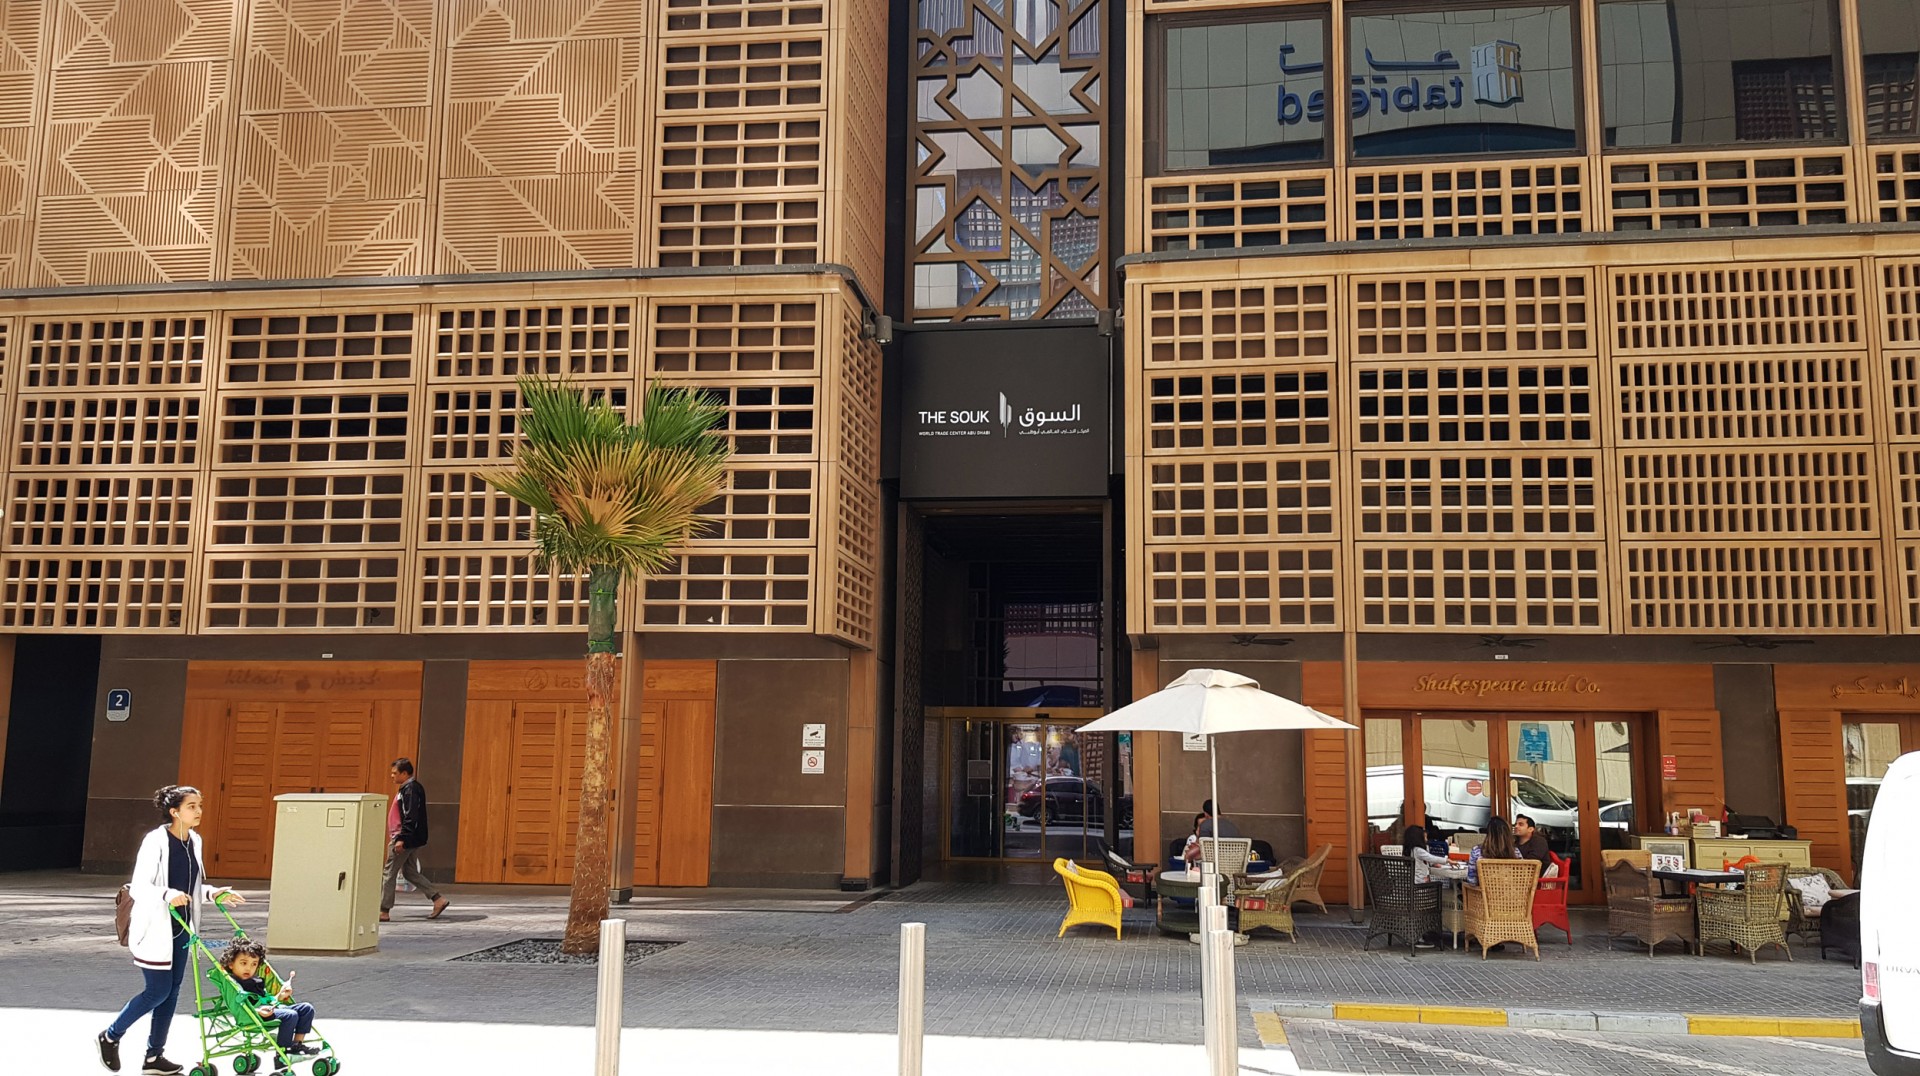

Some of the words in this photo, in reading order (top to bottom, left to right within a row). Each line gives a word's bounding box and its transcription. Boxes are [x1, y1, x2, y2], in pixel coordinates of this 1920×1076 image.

[918, 410, 947, 424] THE
[949, 410, 990, 424] SOUK
[1018, 403, 1081, 428] السوق
[1413, 671, 1528, 697] Shakespeare
[1532, 673, 1576, 692] and
[1575, 677, 1601, 694] Co.
[115, 694, 123, 707] 2
